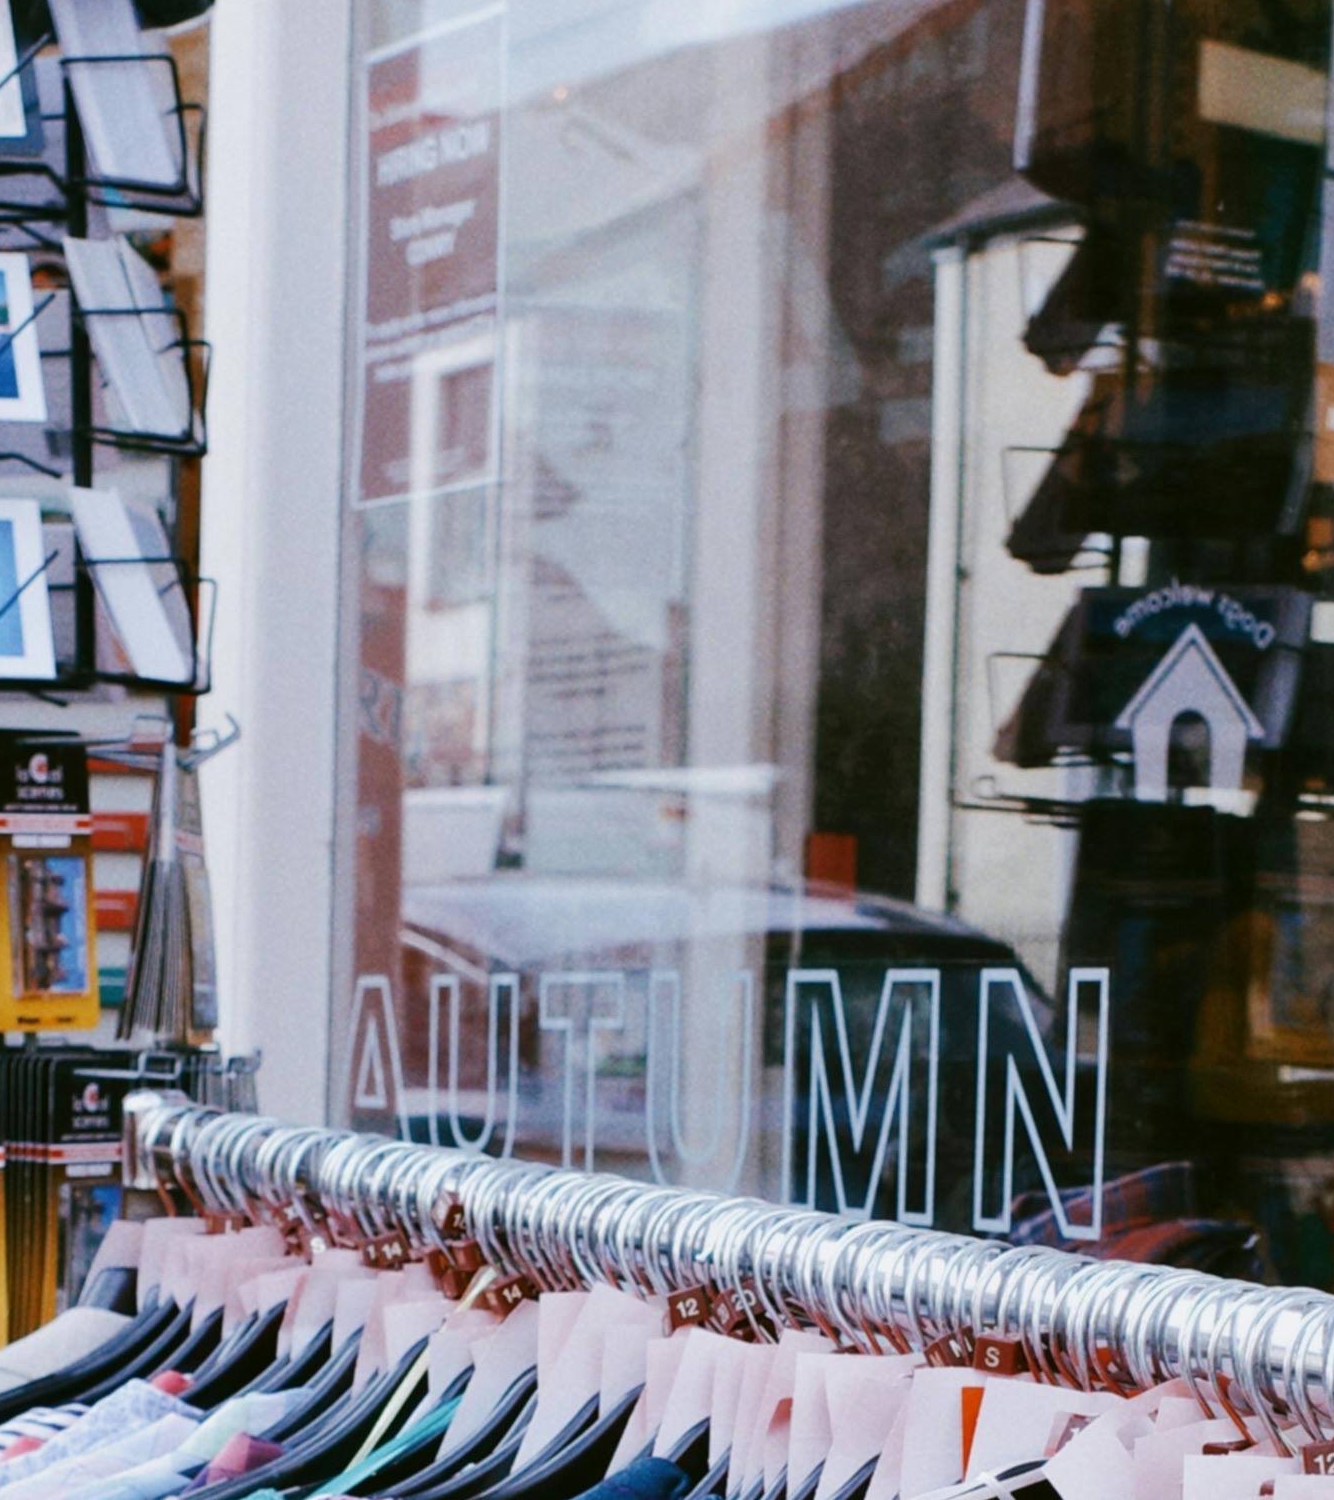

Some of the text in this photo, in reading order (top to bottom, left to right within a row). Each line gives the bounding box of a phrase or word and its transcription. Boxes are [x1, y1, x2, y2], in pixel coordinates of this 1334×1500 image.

[347, 966, 1111, 1242] AUTUMN
[501, 1283, 522, 1303] 14
[676, 1297, 700, 1319] 12
[984, 1346, 1001, 1368] S
